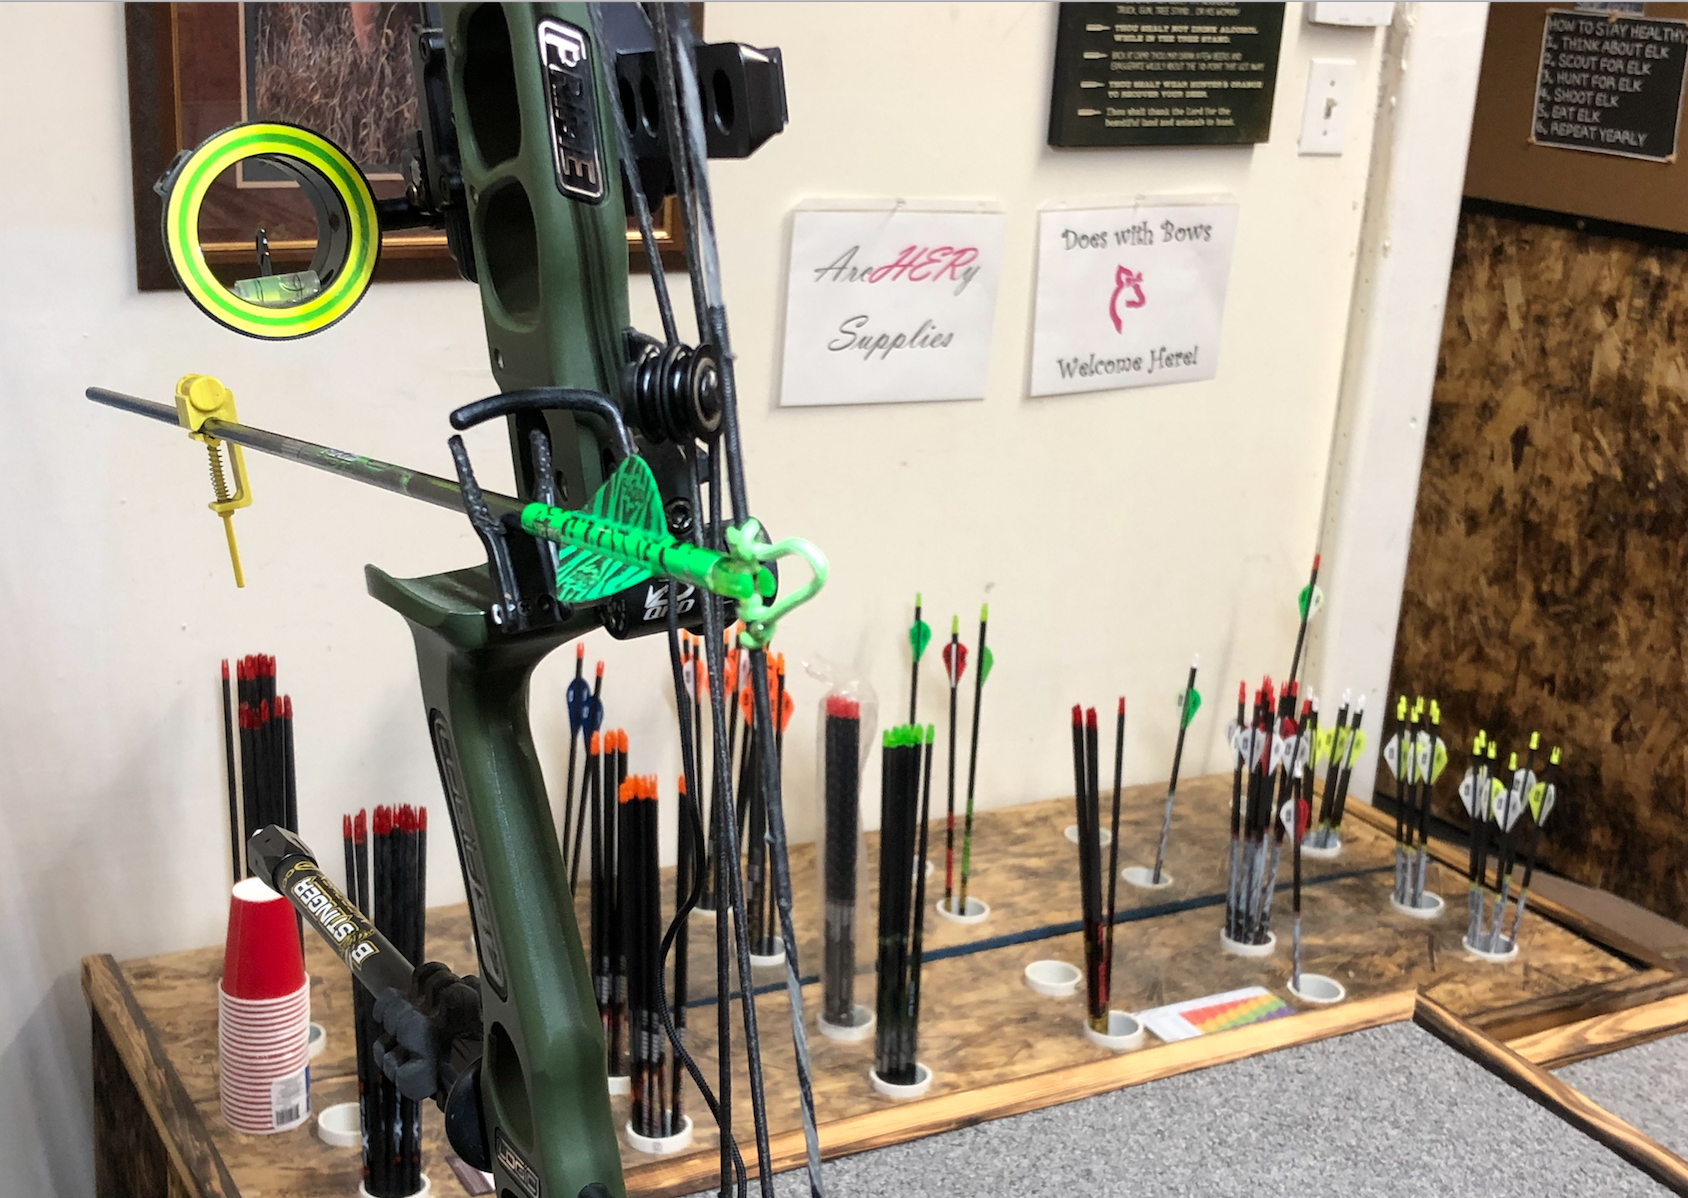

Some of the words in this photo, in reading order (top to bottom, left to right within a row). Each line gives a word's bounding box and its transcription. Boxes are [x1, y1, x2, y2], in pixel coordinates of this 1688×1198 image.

[1550, 19, 1575, 33] HOW
[1579, 21, 1594, 35] TO
[1595, 22, 1627, 38] STAY
[1562, 37, 1599, 52] THINK
[1601, 40, 1643, 55] ABOUT
[1644, 45, 1670, 59] ELK
[1543, 53, 1556, 67] 2.
[1558, 53, 1598, 70] SCOUT
[1600, 57, 1624, 72] FOR
[1627, 61, 1652, 75] ELK
[1541, 69, 1554, 84] 3.
[1557, 71, 1590, 87] HUNT
[1591, 75, 1615, 90] FOR
[1618, 78, 1644, 93] ELK
[1554, 88, 1593, 103] SHOOT
[1595, 94, 1620, 108] ELK
[1552, 105, 1575, 120] EAT
[1577, 110, 1601, 124] ELK
[1550, 122, 1598, 140] REPEAT
[1600, 128, 1648, 148] YEARLY
[1061, 225, 1108, 251] Does
[1114, 220, 1154, 247] with
[1160, 218, 1213, 244] Bows
[814, 245, 980, 297] ArcHERy
[828, 315, 953, 361] Supplies
[1057, 353, 1142, 380] Welcome
[1147, 344, 1199, 376] Here!
[292, 875, 357, 944] STINGER
[351, 941, 375, 965] B
